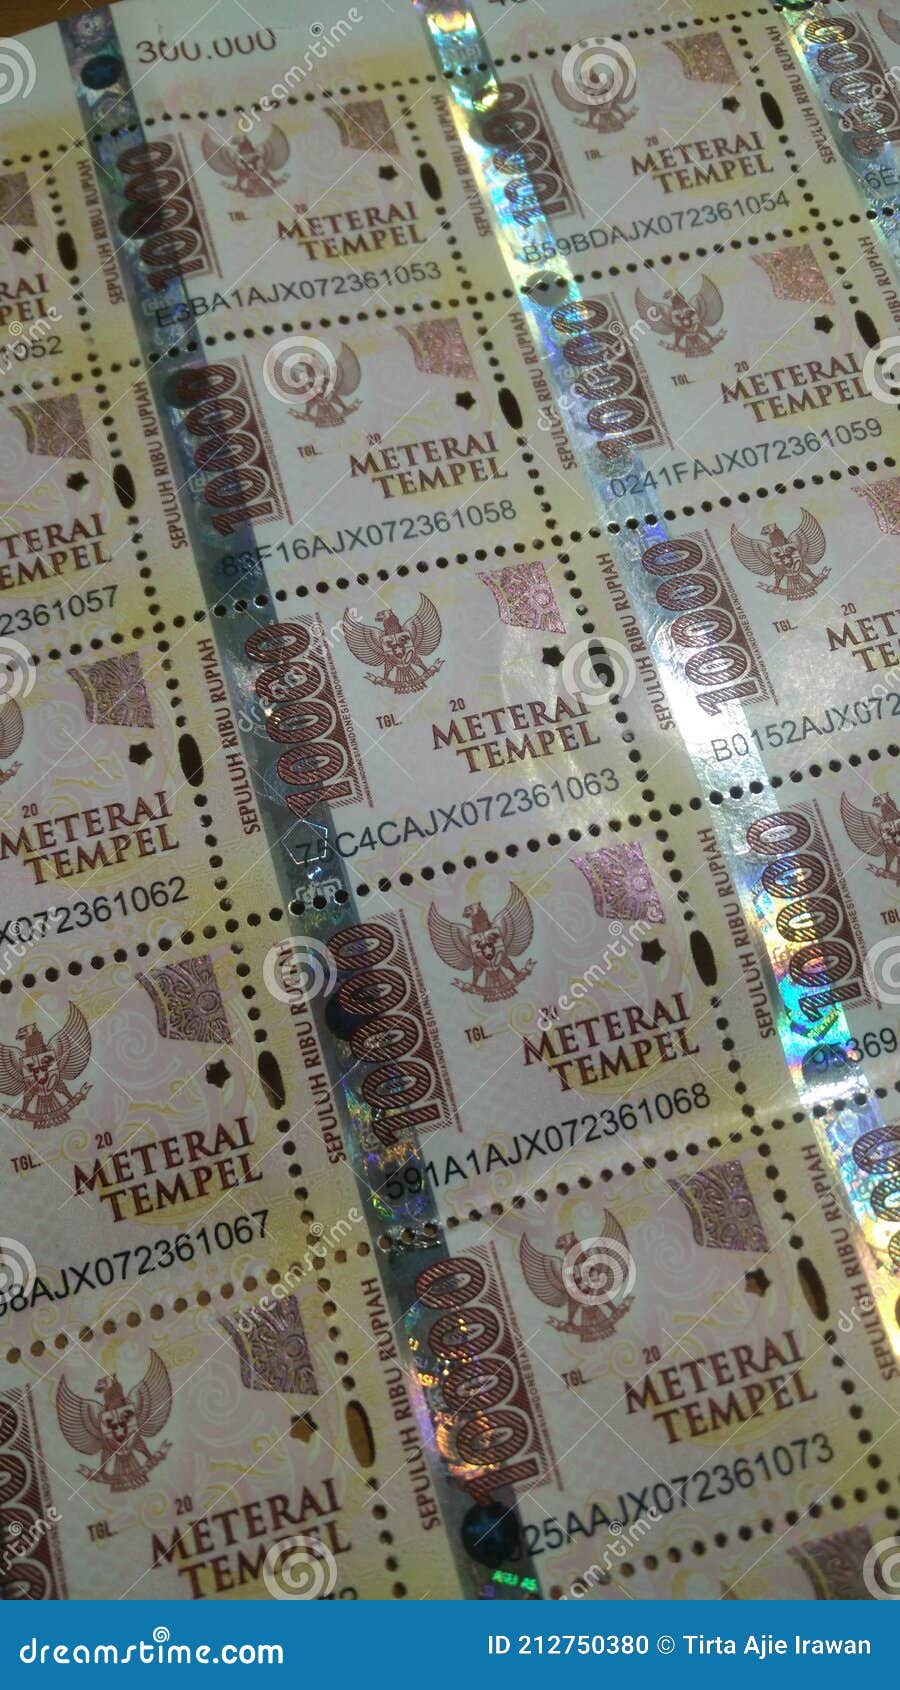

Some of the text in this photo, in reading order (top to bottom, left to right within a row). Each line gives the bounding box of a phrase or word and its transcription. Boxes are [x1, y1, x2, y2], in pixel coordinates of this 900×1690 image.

[765, 25, 797, 72] RUPIAH
[789, 74, 811, 105] RIBU
[631, 131, 766, 177] METERAI
[652, 154, 775, 194] TEMPEL
[277, 201, 420, 240] METERAI
[297, 224, 428, 260] TEMPEL
[510, 312, 539, 365] RUPIAH
[734, 360, 749, 372] 20
[531, 369, 552, 402] RIBU
[551, 300, 655, 460] 10000
[720, 352, 863, 404] METERAI
[744, 377, 872, 423] TEMPEL
[134, 381, 189, 551] SEPULUH RIBU RUPIAH
[175, 365, 274, 537] 10000
[349, 431, 500, 478] METERAI
[372, 457, 508, 499] TEMPEL
[609, 418, 883, 498] 0241FAJX072361059
[641, 539, 759, 716] 10000
[826, 609, 900, 651] MET
[841, 602, 857, 616] 20
[596, 553, 676, 731] SEPULUH RIBU RUPIAH
[851, 640, 900, 673] TE
[244, 623, 352, 819] 10000
[432, 691, 592, 750] METERAI
[450, 698, 466, 712] 20
[197, 638, 261, 835] SEPULUH RIBU RUPIAH
[456, 720, 601, 773] TEMPEL
[0, 790, 173, 860] METERAI
[22, 803, 39, 818] 20
[23, 824, 180, 885] TEMPEL
[697, 828, 776, 1039] SEPULUH RIBU RUPIAH
[747, 811, 862, 1022] 10000
[293, 1021, 322, 1070] RIBU
[327, 923, 442, 1147] 10000
[523, 992, 691, 1066] METERAI
[548, 1027, 700, 1092] TEMPEL
[95, 1131, 113, 1149] 20
[308, 1073, 348, 1165] SEPULUH
[385, 1082, 711, 1199] 591A1AJX072361068
[73, 1116, 255, 1197] METERAI
[801, 1143, 842, 1222] RUPIAH
[100, 1153, 263, 1223] TEMPEL
[830, 1227, 863, 1278] RIBU
[360, 1277, 398, 1363] RUPIAH
[415, 1257, 540, 1505] 10000
[624, 1330, 805, 1414] METERAI
[642, 1345, 661, 1364] 20
[383, 1367, 414, 1421] RIBU
[653, 1369, 818, 1445] TEMPEL
[175, 1495, 193, 1515] 20
[398, 1425, 441, 1531] SEPULUH
[509, 1432, 835, 1561] 25AAJX072361073
[152, 1477, 342, 1569] METERAI
